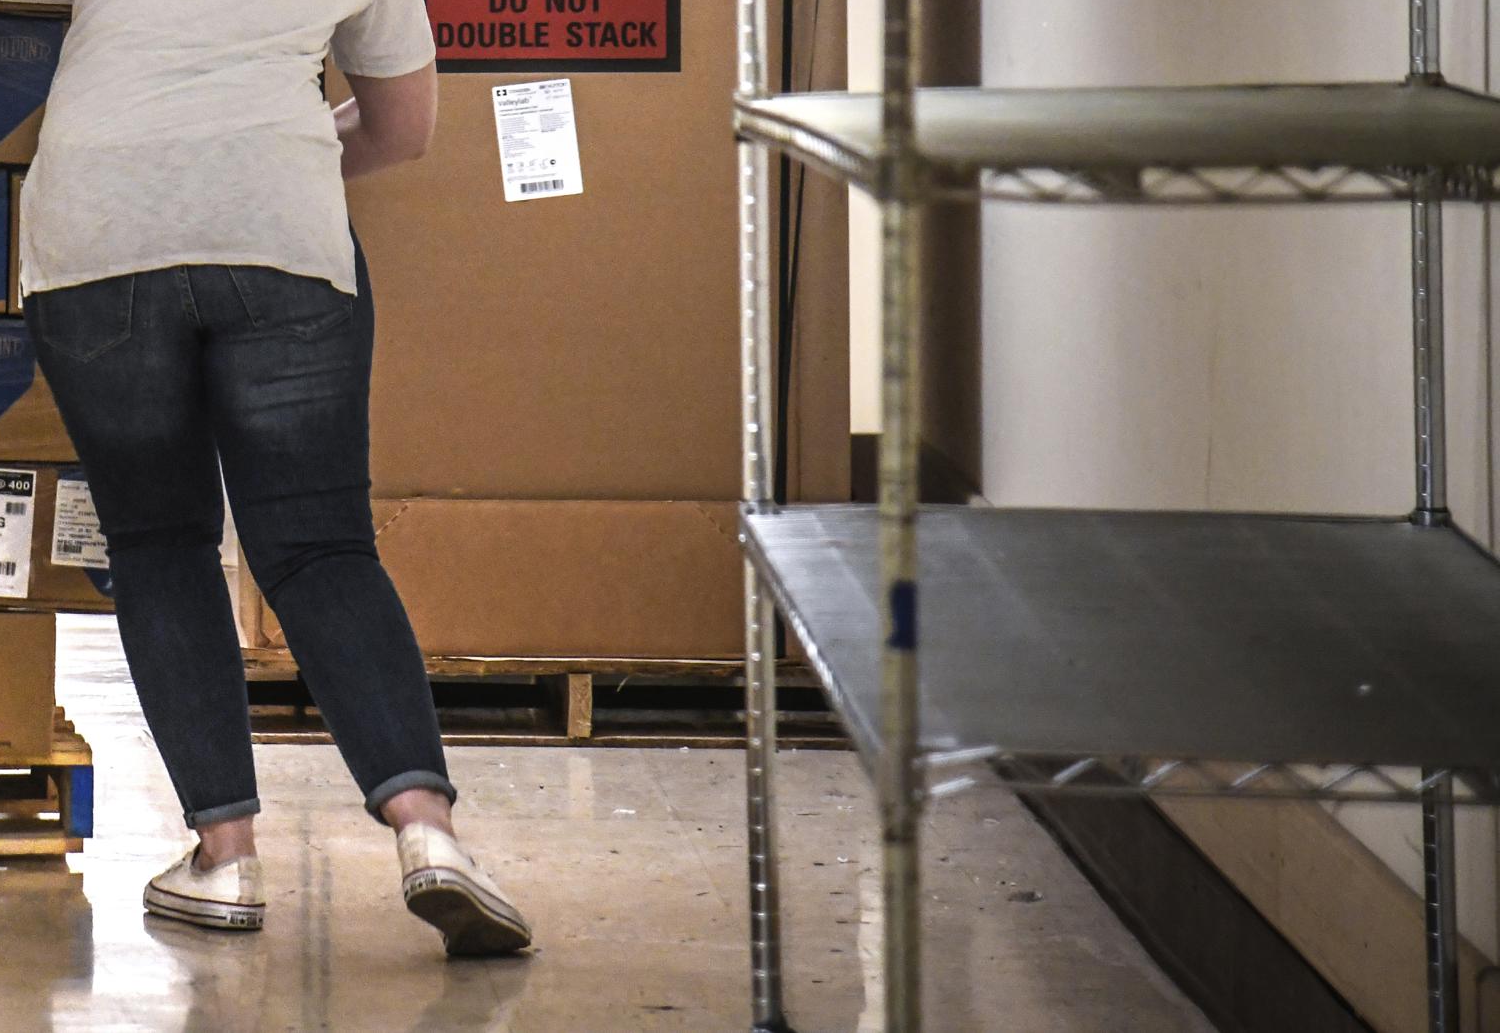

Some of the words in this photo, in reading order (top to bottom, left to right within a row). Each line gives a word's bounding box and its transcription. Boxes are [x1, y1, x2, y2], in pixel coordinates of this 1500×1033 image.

[437, 21, 550, 48] DOUBLE
[566, 21, 657, 48] STACK
[8, 480, 30, 490] 400
